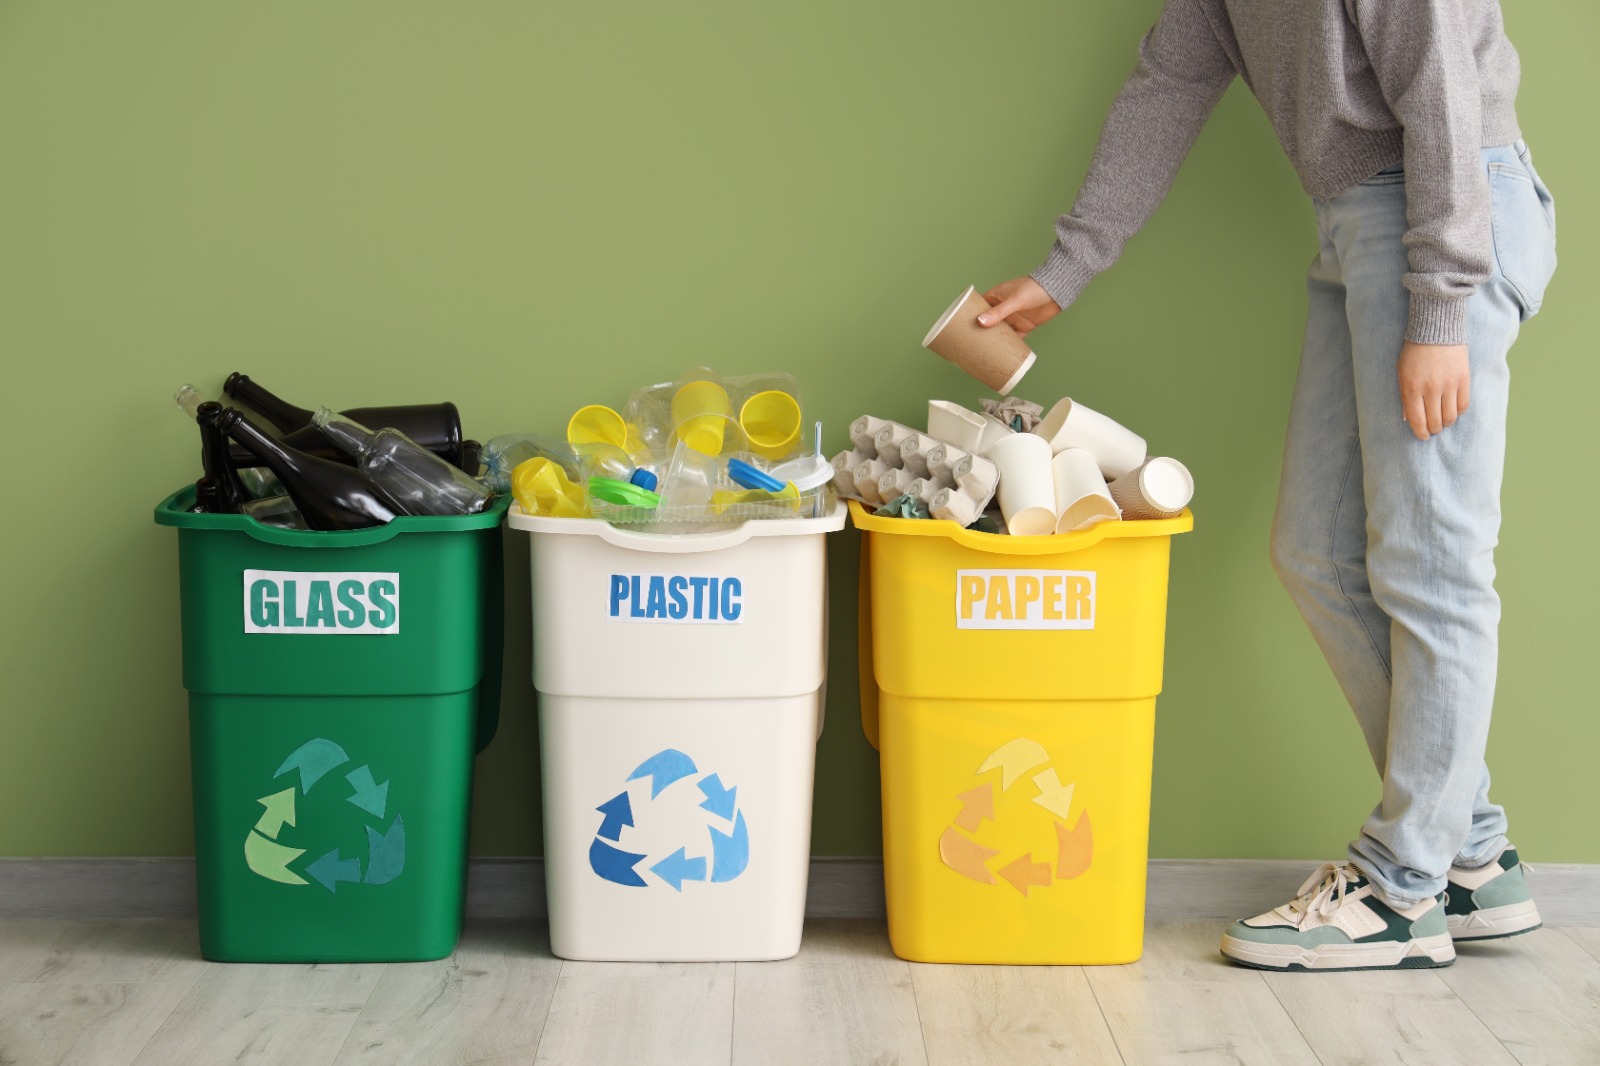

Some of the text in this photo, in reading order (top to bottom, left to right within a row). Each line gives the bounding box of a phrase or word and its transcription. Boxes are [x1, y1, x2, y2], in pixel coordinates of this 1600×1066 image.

[250, 579, 396, 628] GLASS
[610, 575, 742, 621] PLASTIC
[960, 575, 1091, 620] PAPER
